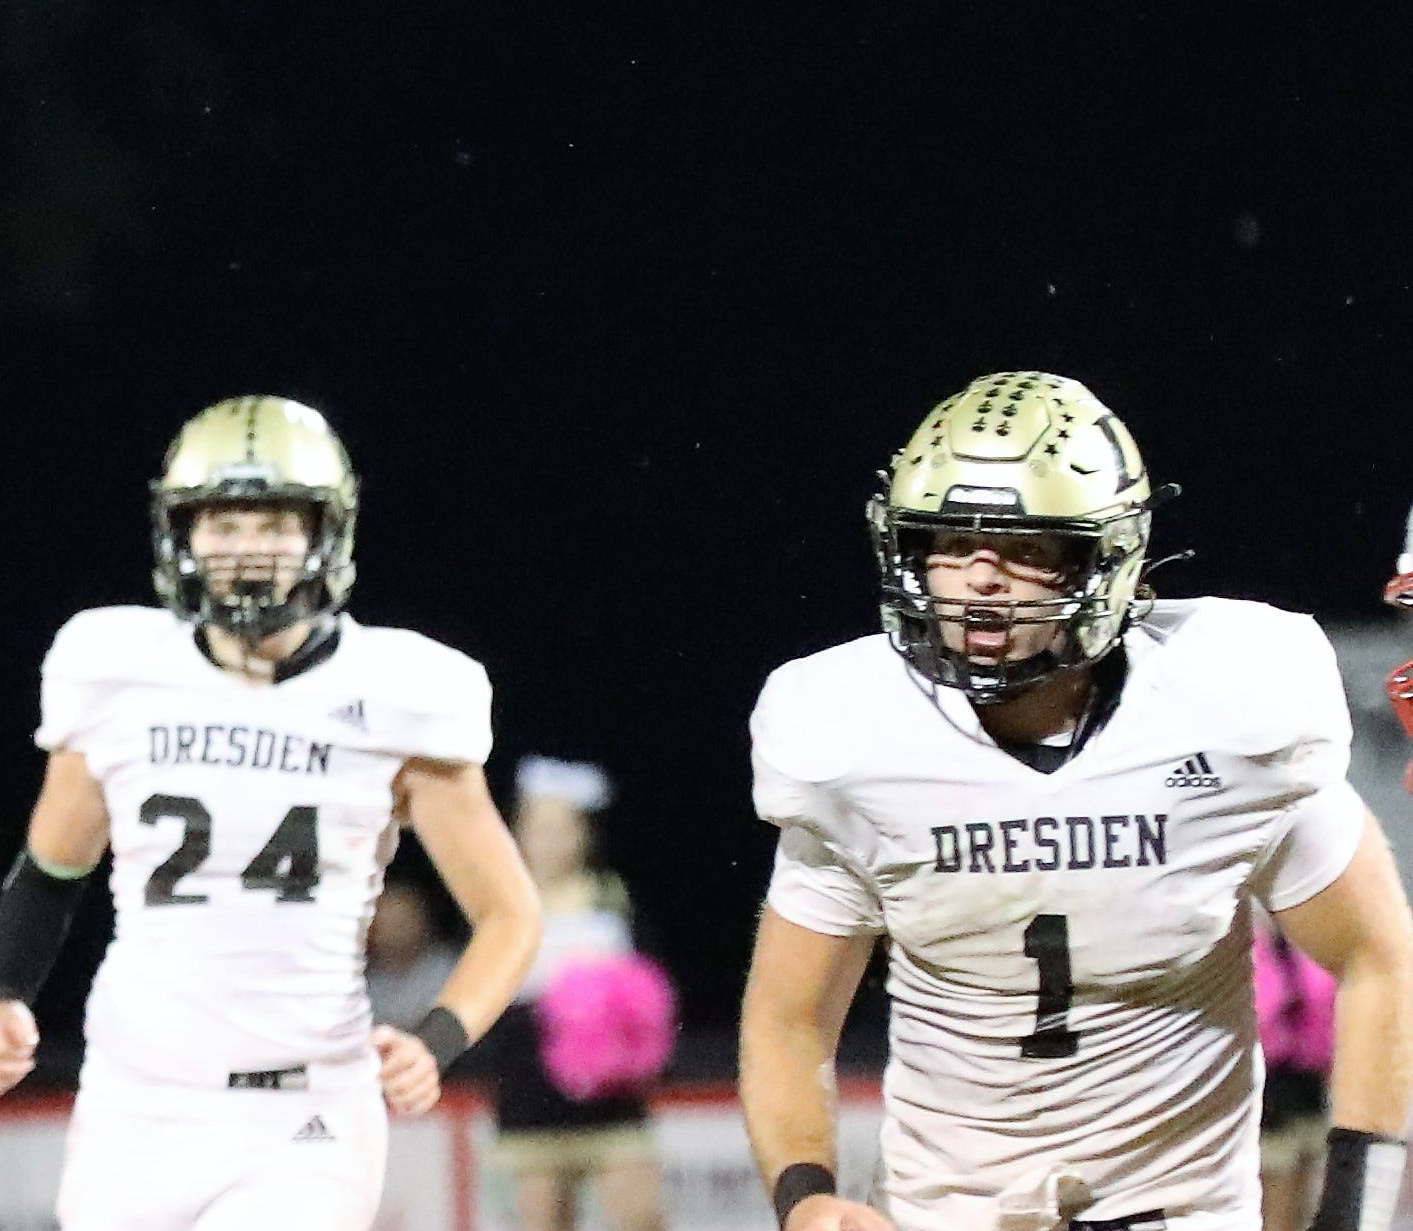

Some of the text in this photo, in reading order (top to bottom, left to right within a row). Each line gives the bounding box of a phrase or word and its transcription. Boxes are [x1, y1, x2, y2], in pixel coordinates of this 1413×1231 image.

[148, 725, 335, 774] DRESDEN
[139, 793, 321, 906] 24
[931, 814, 1168, 873] DRESDEN
[1019, 914, 1081, 1059] 1
